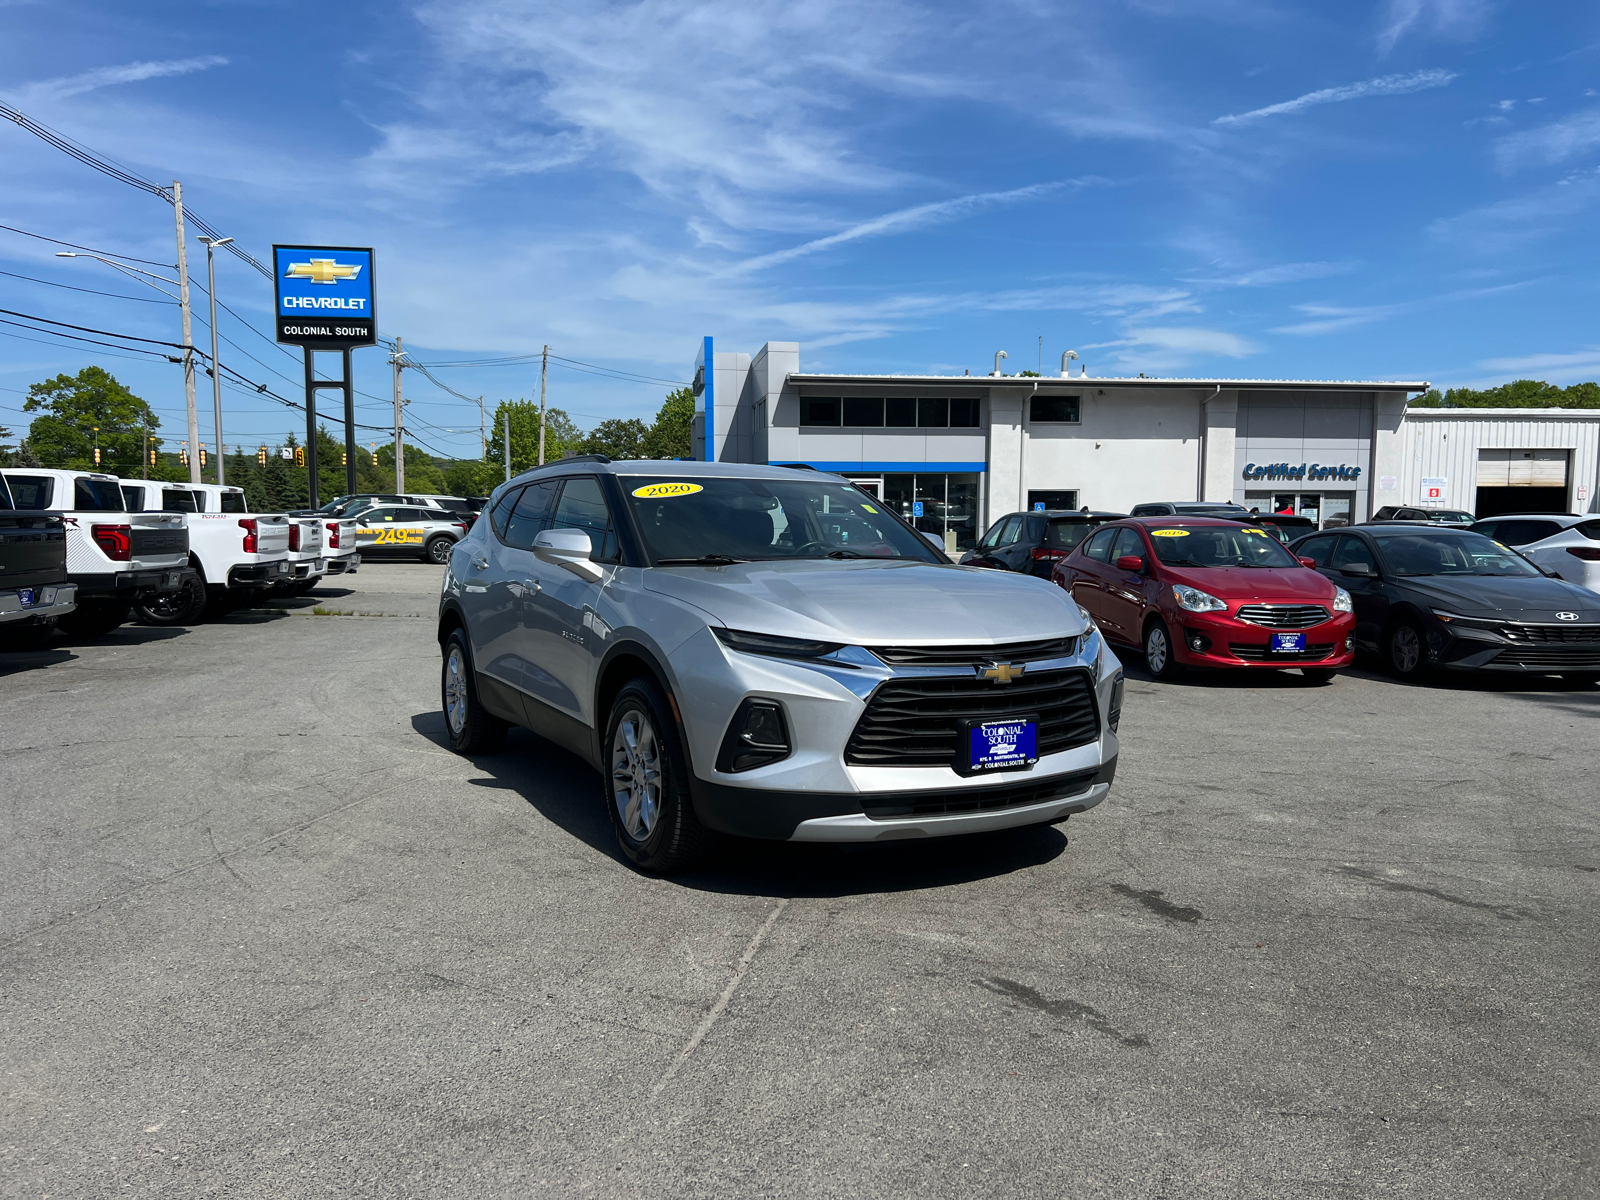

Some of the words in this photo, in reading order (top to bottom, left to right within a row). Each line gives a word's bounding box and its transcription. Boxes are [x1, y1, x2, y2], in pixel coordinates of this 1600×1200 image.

[283, 296, 366, 310] CHEVROLET
[283, 325, 333, 336] COLONIAL
[335, 327, 368, 336] SOUTH
[1245, 462, 1307, 476] Certified
[1311, 463, 1361, 477] Service
[646, 484, 691, 496] 2020
[983, 726, 1024, 737] COLONIAL
[988, 734, 1017, 744] SOUTH
